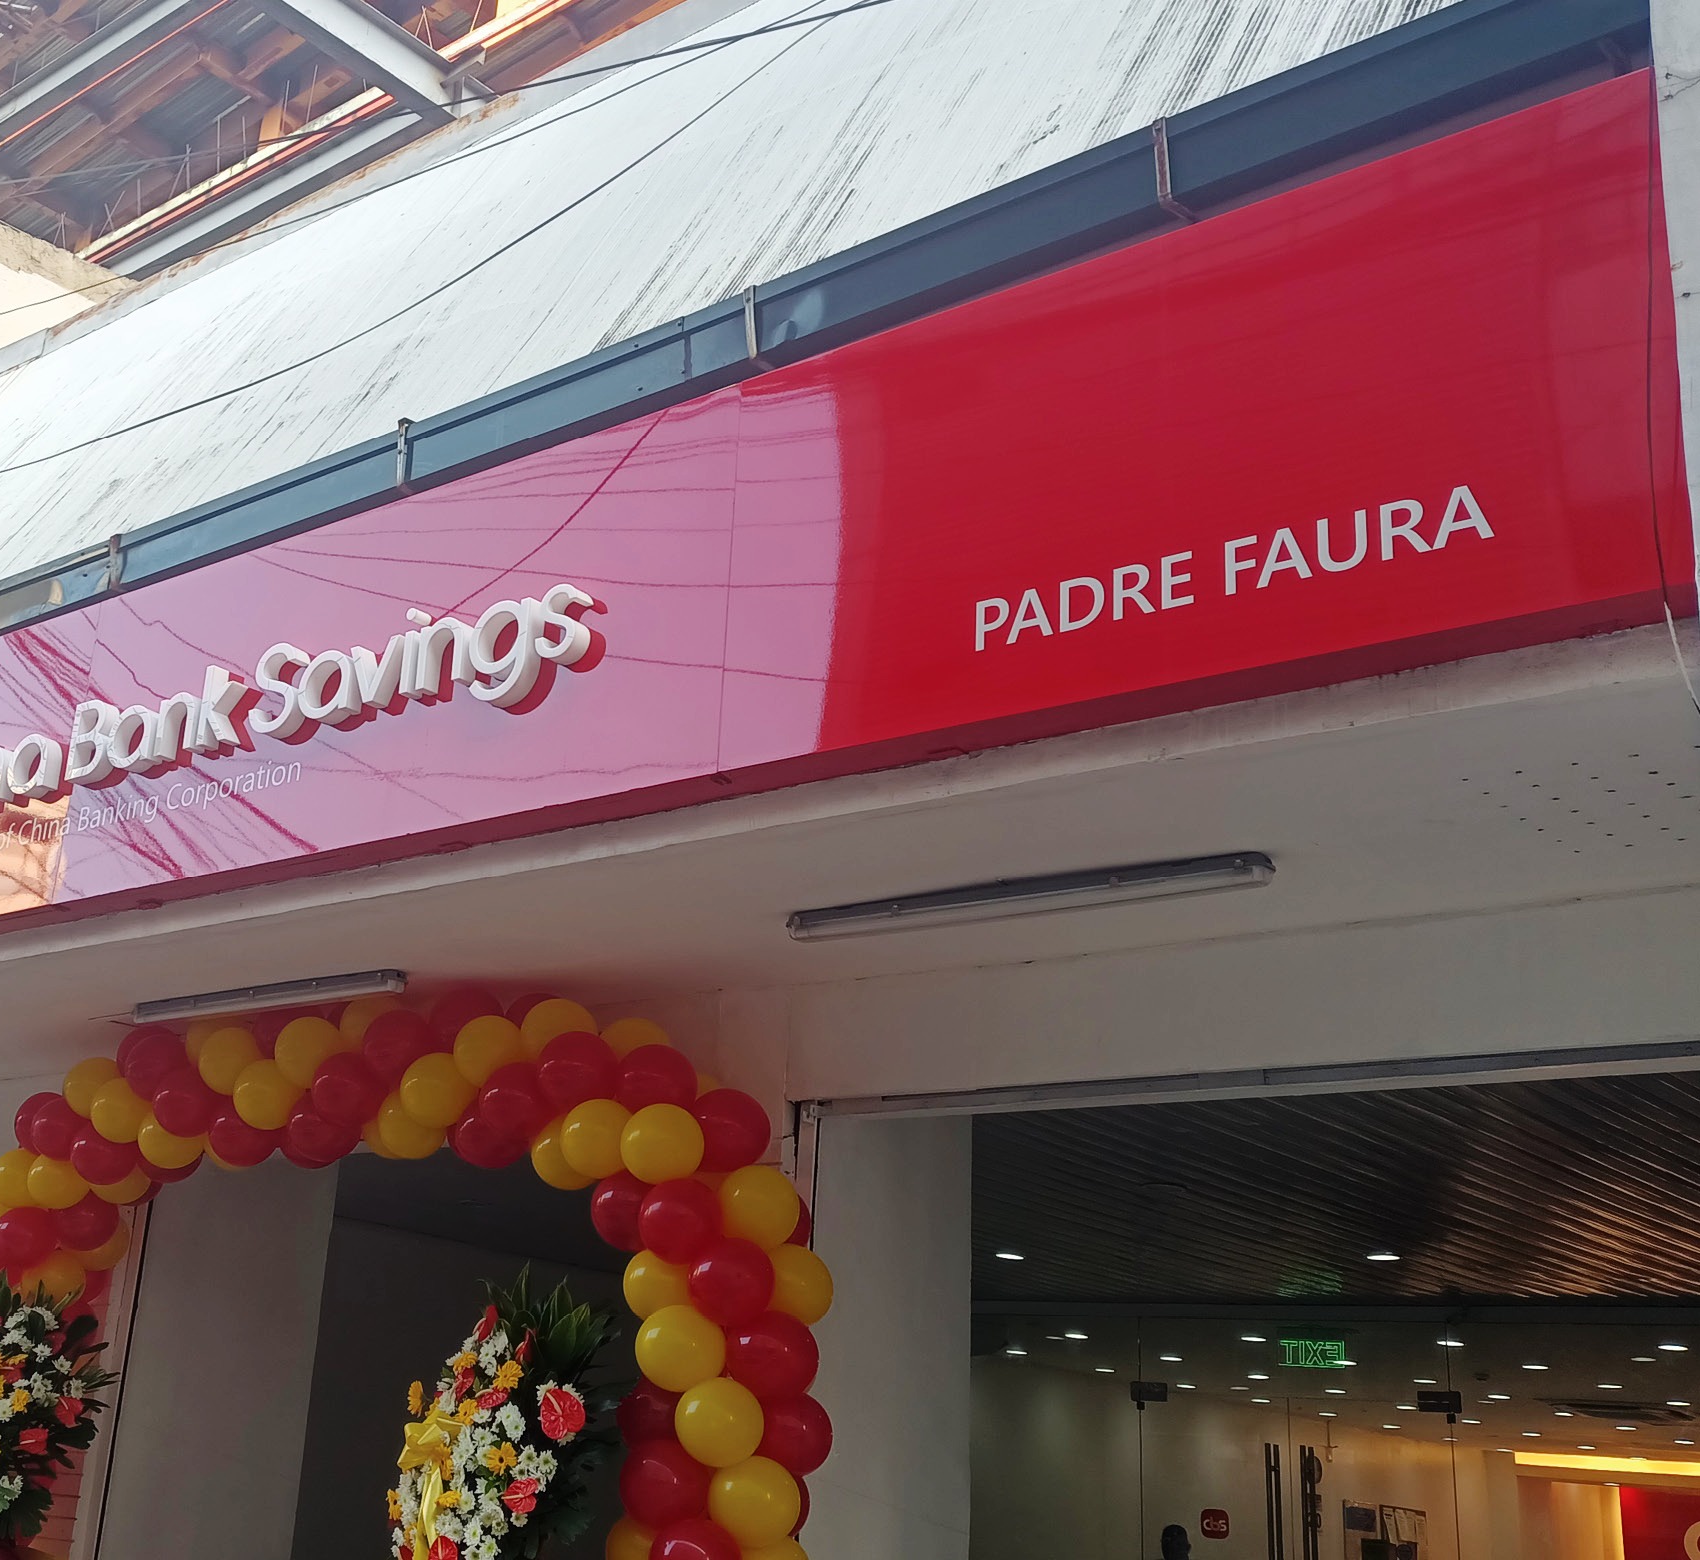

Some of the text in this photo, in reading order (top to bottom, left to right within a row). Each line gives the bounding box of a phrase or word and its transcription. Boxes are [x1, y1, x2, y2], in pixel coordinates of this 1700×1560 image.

[974, 485, 1495, 652] PADRE FAURA
[65, 664, 250, 782] Bank
[248, 583, 593, 737] Savings
[18, 815, 70, 846] China
[78, 795, 159, 832] Banking
[166, 760, 302, 810] Corporation
